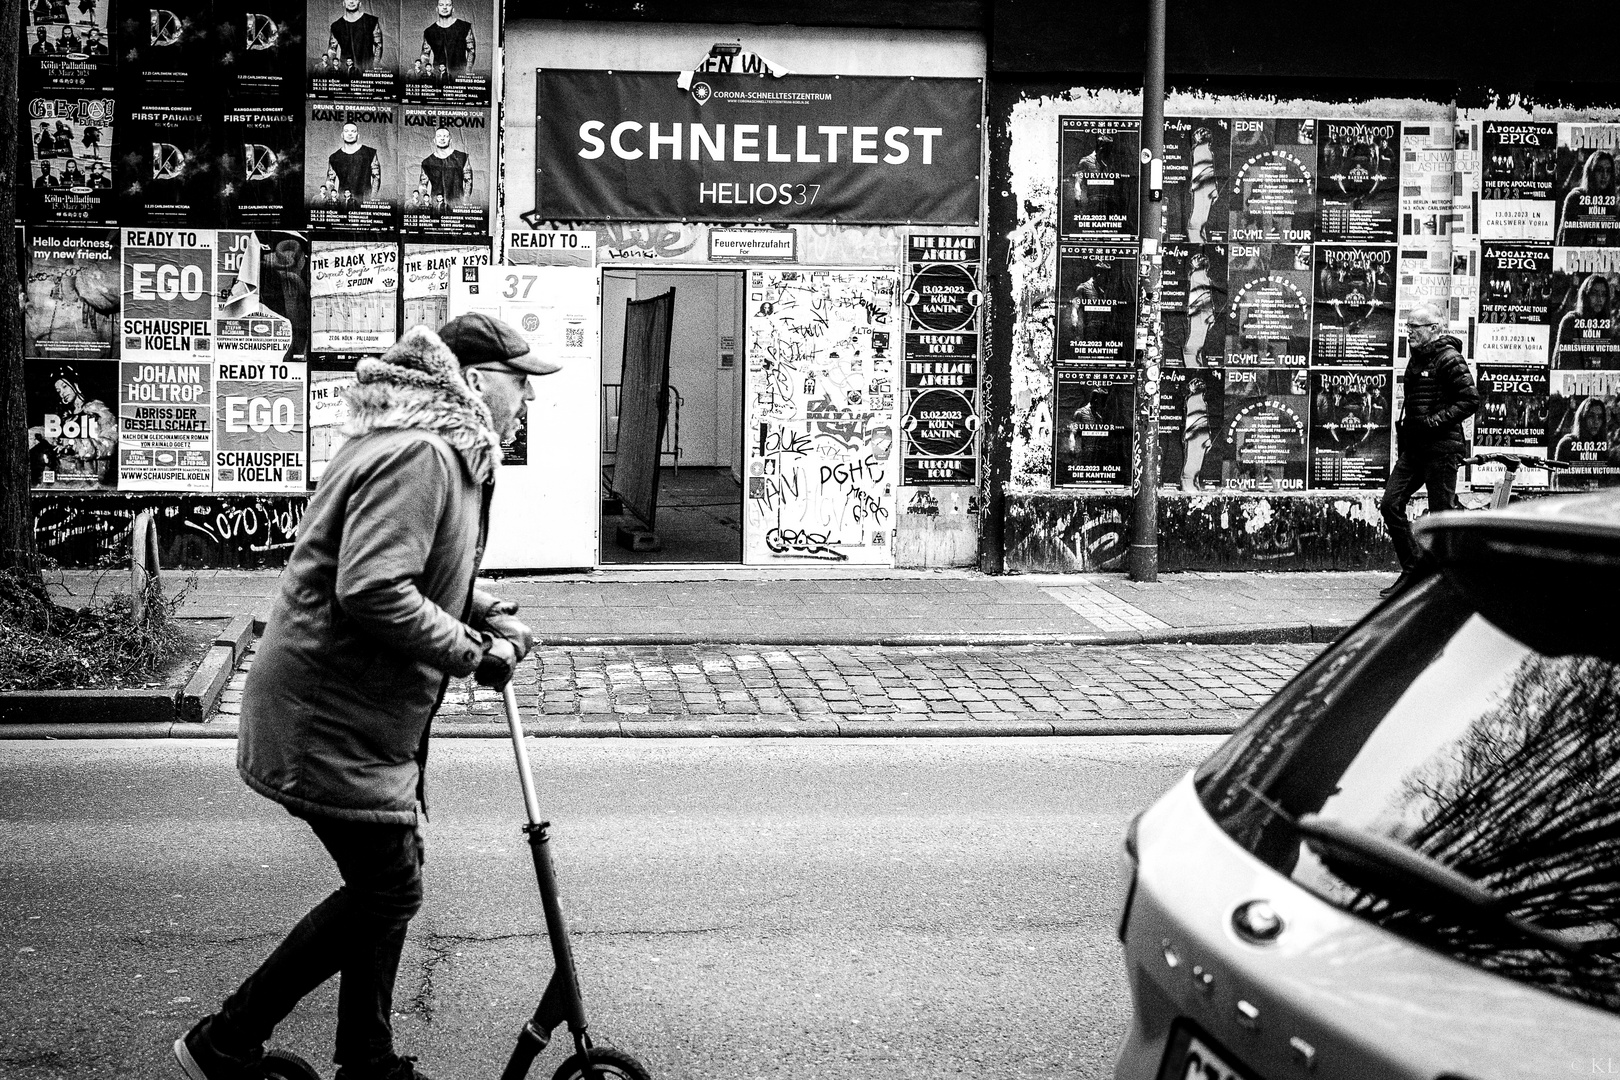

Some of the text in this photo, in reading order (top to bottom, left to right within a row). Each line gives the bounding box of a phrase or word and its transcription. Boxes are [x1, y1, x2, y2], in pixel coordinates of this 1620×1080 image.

[713, 91, 832, 101] CORONA-SCHNELLTESTZENTRUM
[131, 113, 202, 122] FIRST PARADE
[223, 114, 294, 122] FIRST PARADE
[311, 110, 393, 124] KANE BROWN
[404, 115, 485, 128] KANE BROWN
[1235, 121, 1264, 132] EDEN
[1327, 123, 1394, 139] BLOODYWOOD
[578, 120, 943, 166] SCHNELLTEST
[700, 182, 821, 205] HELIOS37
[1485, 188, 1520, 200] 2023
[1579, 195, 1616, 206] 26.03.23
[1588, 205, 1607, 215] KÖLN
[1564, 220, 1620, 230] CARLSWERK VICTO
[127, 231, 197, 247] READY TO
[1232, 229, 1311, 240] ICYMI TOUR
[33, 237, 113, 250] Hello darkness,
[511, 233, 578, 248] READY TO
[714, 238, 791, 250] Feuerwehrzufahrt
[938, 237, 976, 249] BLACK
[34, 250, 112, 260] my new friend.
[922, 249, 967, 260] ANGELS
[1231, 247, 1260, 257] EDEN
[1324, 247, 1391, 264] BLOODYWOOD
[312, 252, 396, 270] THE BLACK KEYS
[405, 255, 488, 273] THE BLACK KEYS
[133, 263, 203, 301] EGO
[347, 278, 374, 288] SPOON
[502, 274, 538, 298] 37
[922, 286, 965, 294] 13.02.2023
[930, 295, 956, 304] KÖLN
[922, 305, 964, 313] KANTINE
[1494, 304, 1507, 312] EPIC
[1533, 305, 1547, 313] TOUR
[1481, 311, 1517, 323] 2023
[124, 320, 211, 335] SCHAUSPIEL
[1574, 319, 1611, 329] 26.03.23
[1582, 330, 1601, 338] KÖLN
[145, 336, 191, 351] KOELN
[1559, 344, 1595, 352] CARLSWERK
[1228, 354, 1306, 365] ICYMI TOUR
[220, 365, 288, 380] READY TO
[935, 363, 973, 374] BLACK
[132, 366, 200, 384] JOHANN
[919, 375, 963, 386] ANGELS
[1228, 372, 1257, 382] EDEN
[1320, 371, 1387, 387] BLOODYWOOD
[128, 384, 204, 401] HOLTROP
[311, 389, 329, 399] THE
[135, 408, 197, 419] ABRISS DER
[225, 396, 295, 433] EGO
[920, 411, 962, 419] 13.02.2023
[44, 413, 99, 438] Bolt
[124, 420, 207, 431] GESELLSCHAFT
[928, 419, 954, 429] KÖLN
[921, 430, 961, 438] KANTINE
[1477, 427, 1488, 435] THE
[1476, 435, 1511, 447] 2023
[1571, 441, 1607, 451] 26.03.23
[217, 452, 303, 467] SCHAUSPIEL
[1580, 452, 1598, 460] KÖLN
[1103, 464, 1121, 472] KÖLN
[1556, 466, 1592, 474] CARLSWERK
[121, 472, 210, 480] WWW.SCHAUSPIEL.KOELN
[237, 467, 283, 482] KOELN
[1225, 479, 1304, 489] ICYMI TOUR
